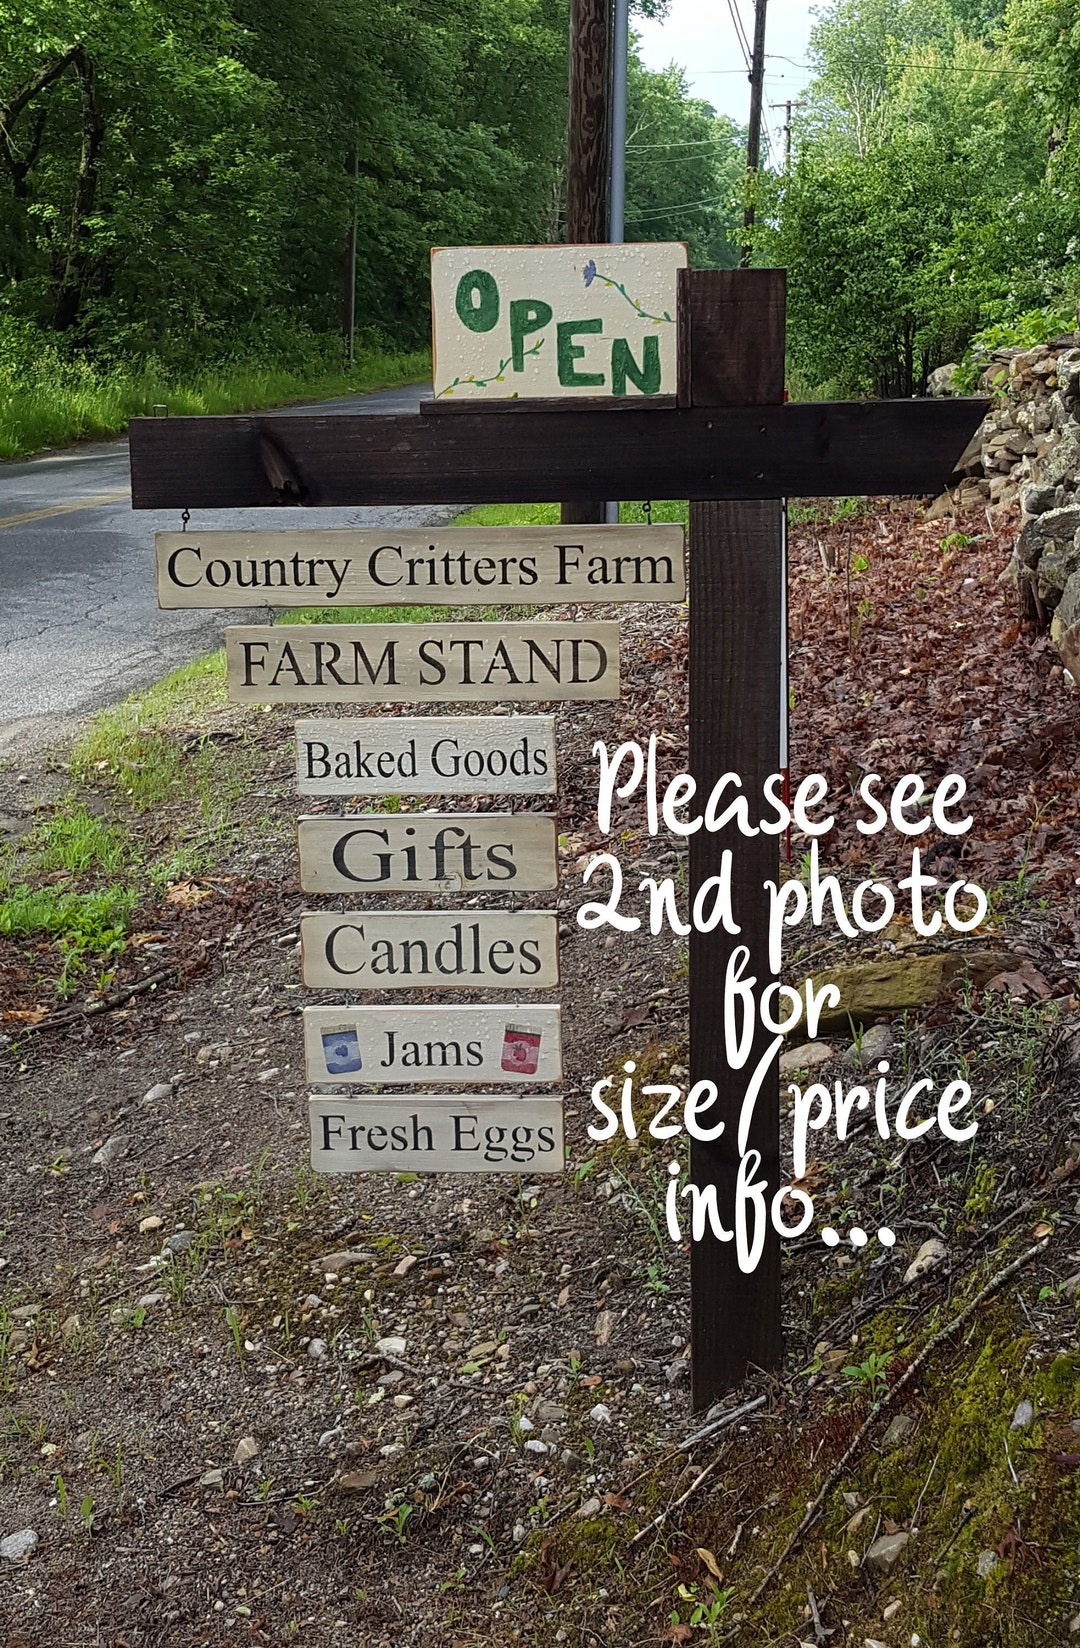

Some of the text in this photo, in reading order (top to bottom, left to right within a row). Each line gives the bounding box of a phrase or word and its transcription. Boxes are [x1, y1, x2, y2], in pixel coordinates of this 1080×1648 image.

[455, 269, 662, 396] OPEN
[167, 545, 675, 598] Country Critters Farm
[240, 639, 608, 687] FARM STAND
[304, 738, 548, 779] Baked Goods
[332, 827, 518, 883] Gifts
[325, 922, 542, 975] Candles
[380, 1030, 484, 1068] Jams
[319, 1114, 556, 1162] Fresh Eggs
